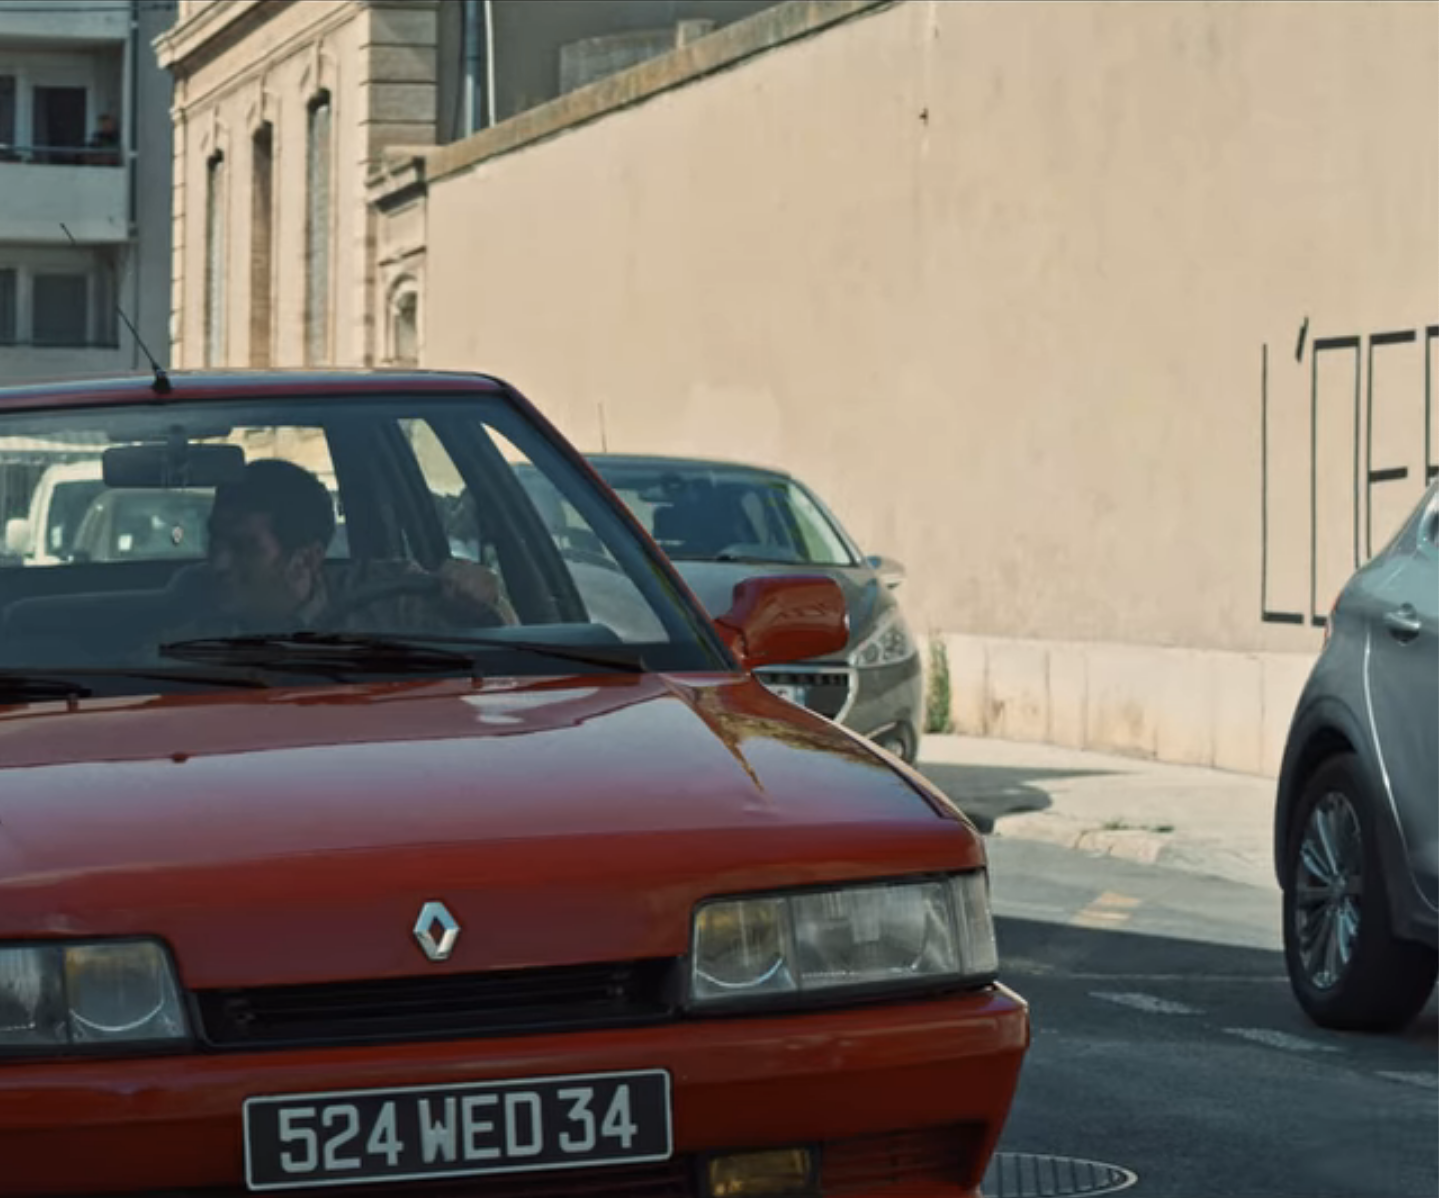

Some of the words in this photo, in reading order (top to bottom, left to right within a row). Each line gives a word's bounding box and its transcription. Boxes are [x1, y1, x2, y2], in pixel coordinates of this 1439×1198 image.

[278, 1101, 404, 1173] 524
[418, 1091, 543, 1163] WED
[557, 1084, 637, 1153] 34
